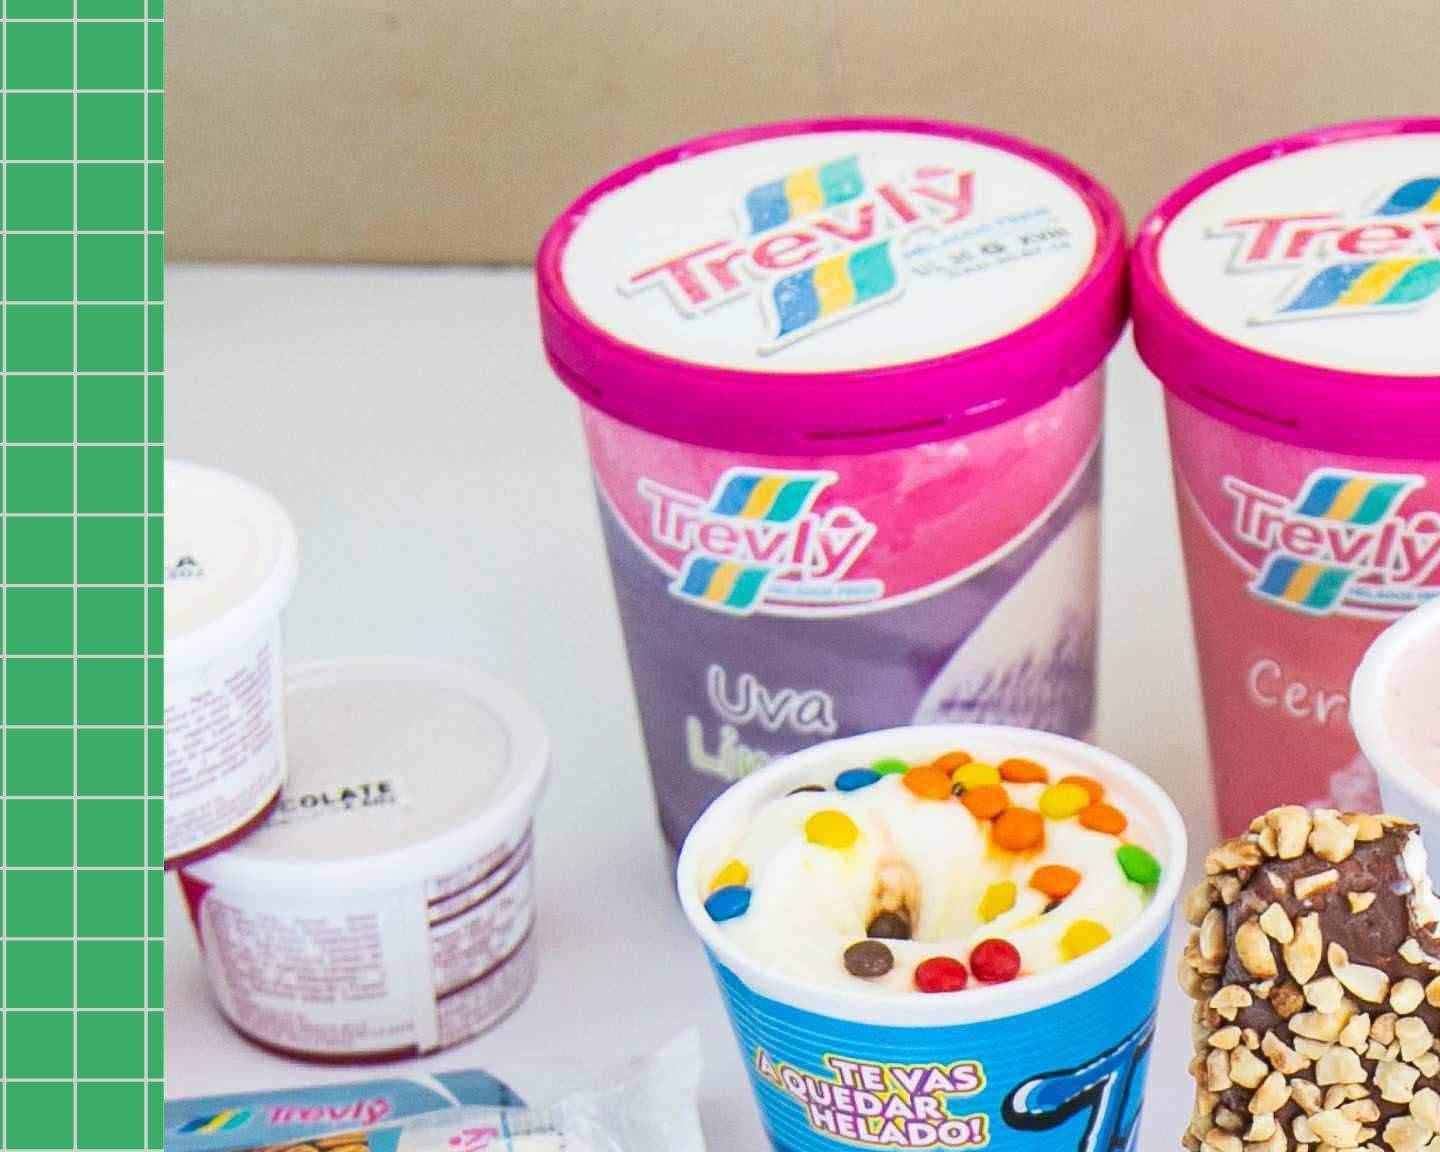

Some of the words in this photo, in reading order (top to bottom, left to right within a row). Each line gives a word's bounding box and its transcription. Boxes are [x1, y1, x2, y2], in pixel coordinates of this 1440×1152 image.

[707, 663, 838, 735] Uva
[757, 1049, 782, 1084] A
[780, 1065, 949, 1121] QUEDAR
[828, 1056, 886, 1092] TE
[889, 1062, 983, 1095] VAS
[810, 1100, 986, 1148] HELADO!
